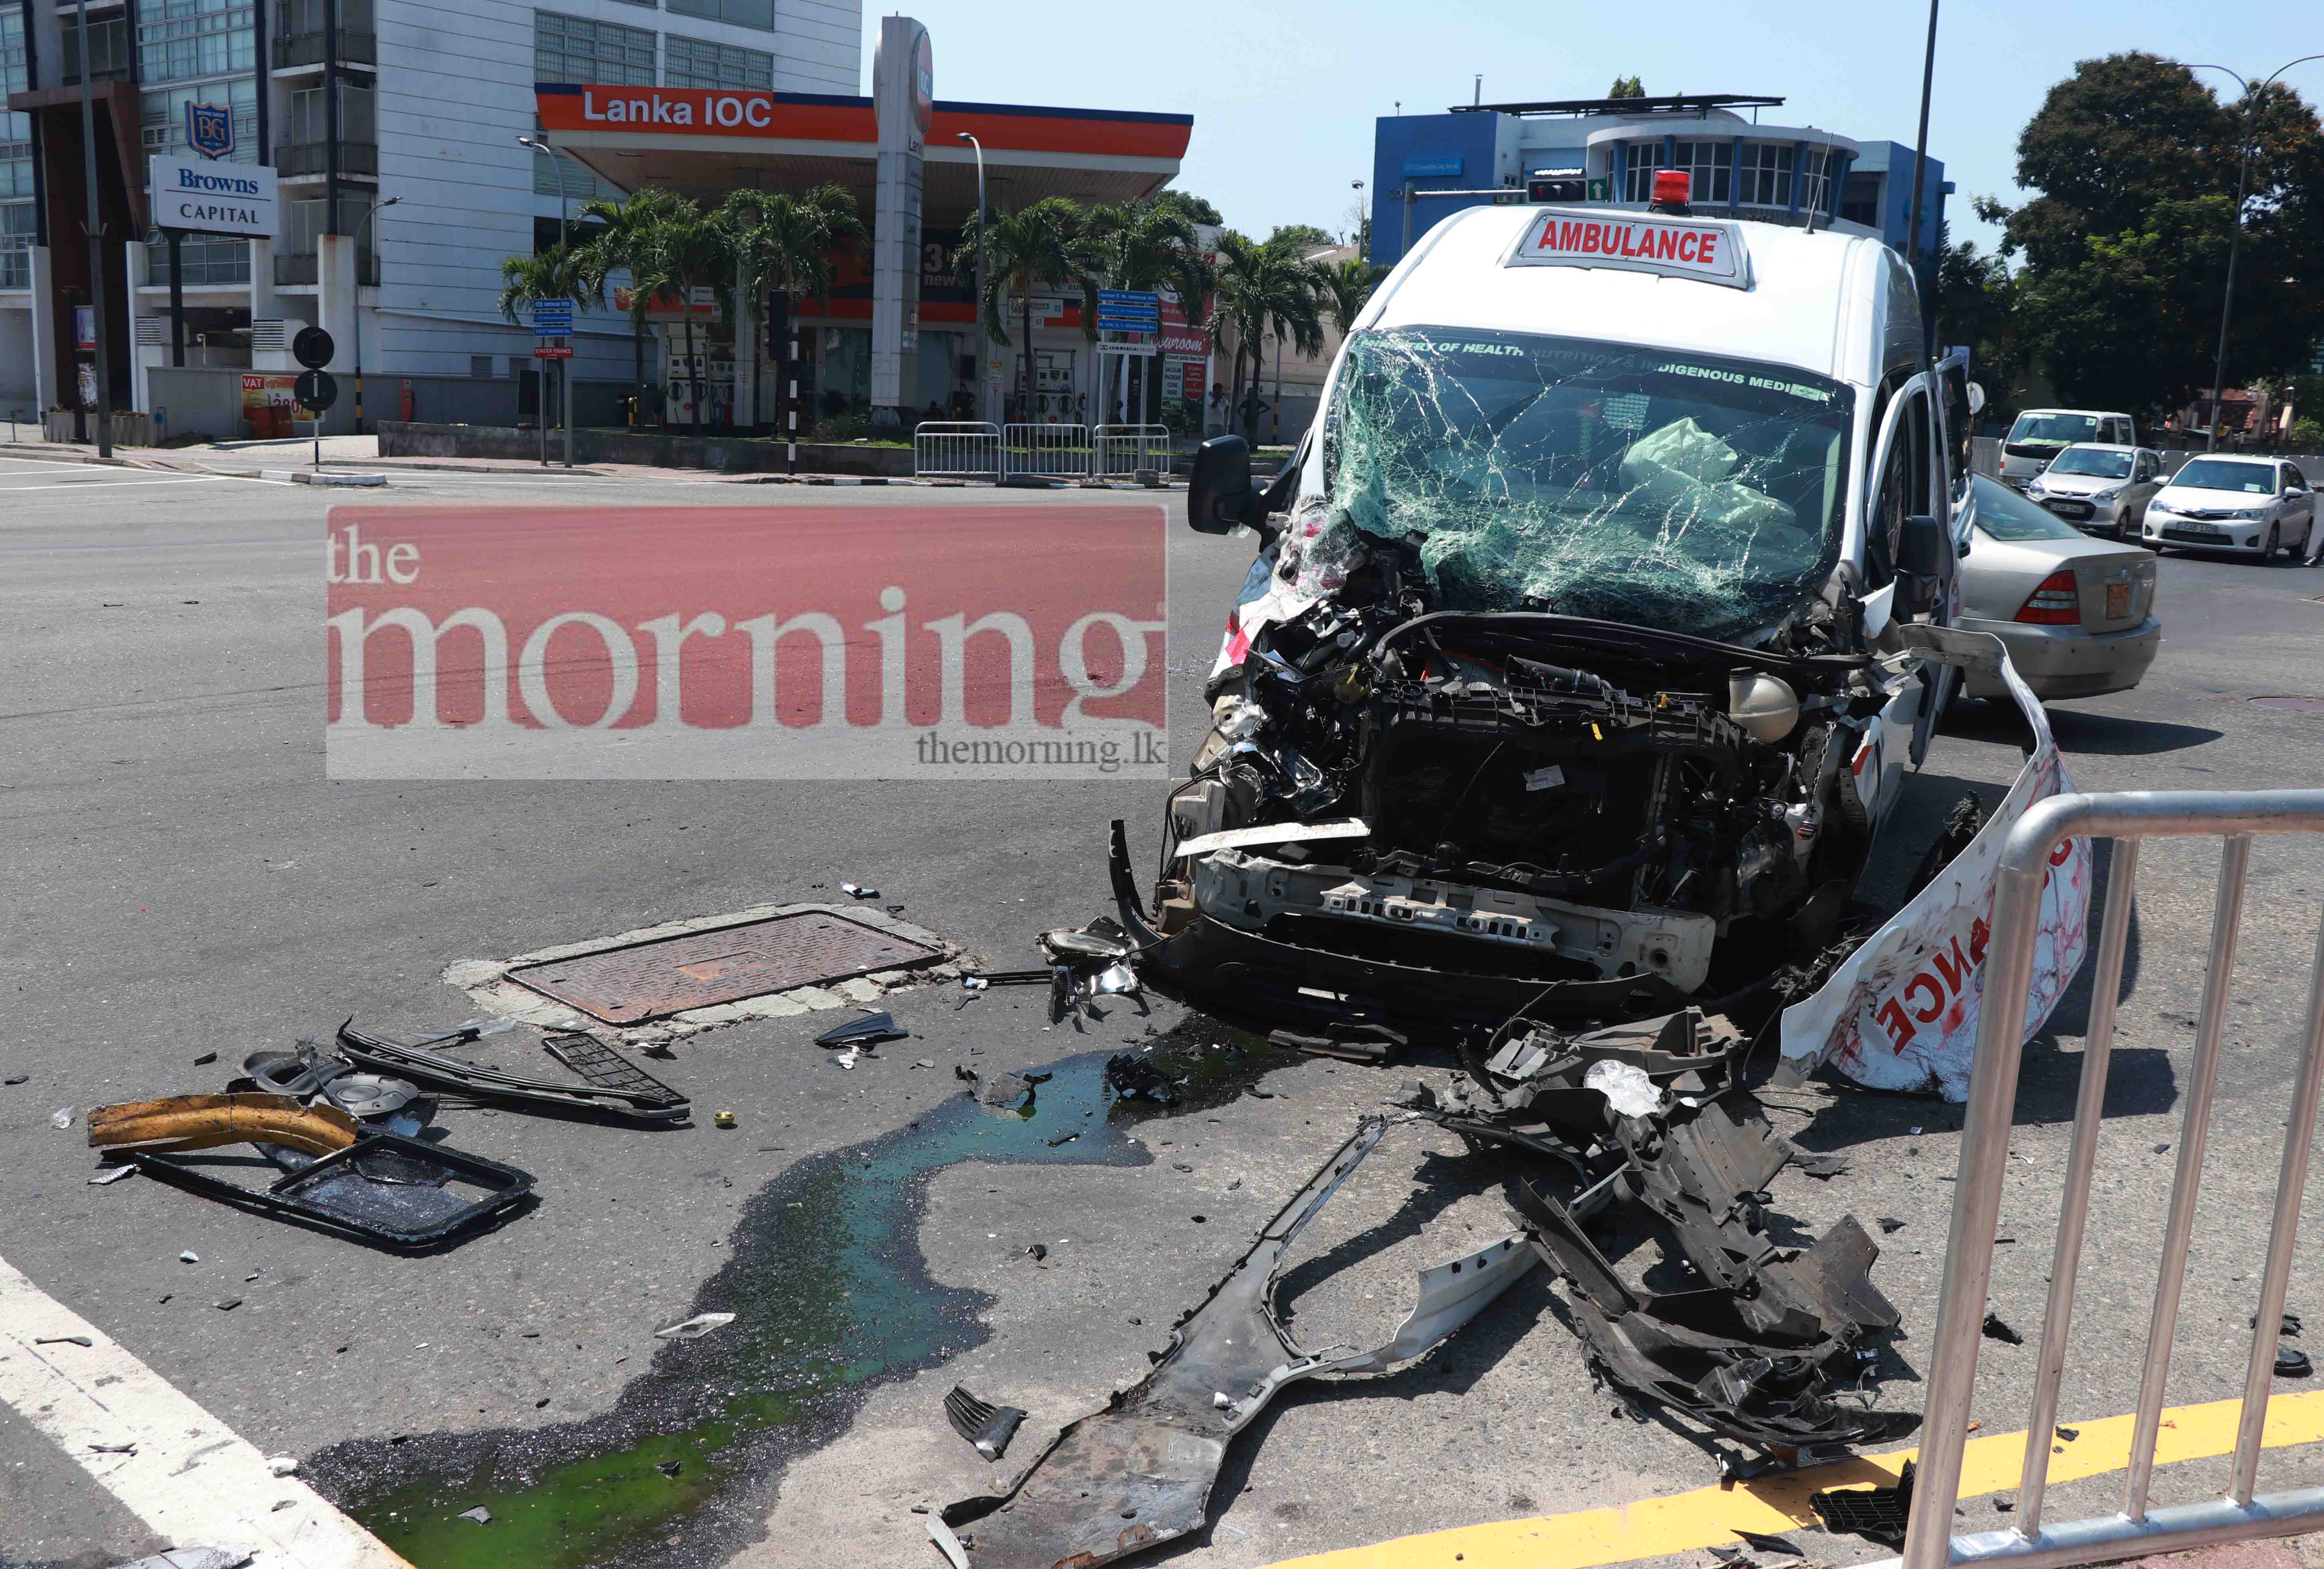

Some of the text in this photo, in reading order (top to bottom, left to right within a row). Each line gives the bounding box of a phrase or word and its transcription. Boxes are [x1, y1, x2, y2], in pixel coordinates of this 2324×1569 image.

[585, 91, 772, 127] Lanka IOC
[198, 116, 226, 141] BG
[178, 168, 258, 194] Browns
[180, 204, 259, 224] CAPITAL
[1538, 220, 1717, 264] AMBULANCE
[1439, 342, 1460, 352] OF
[243, 378, 262, 387] VAT
